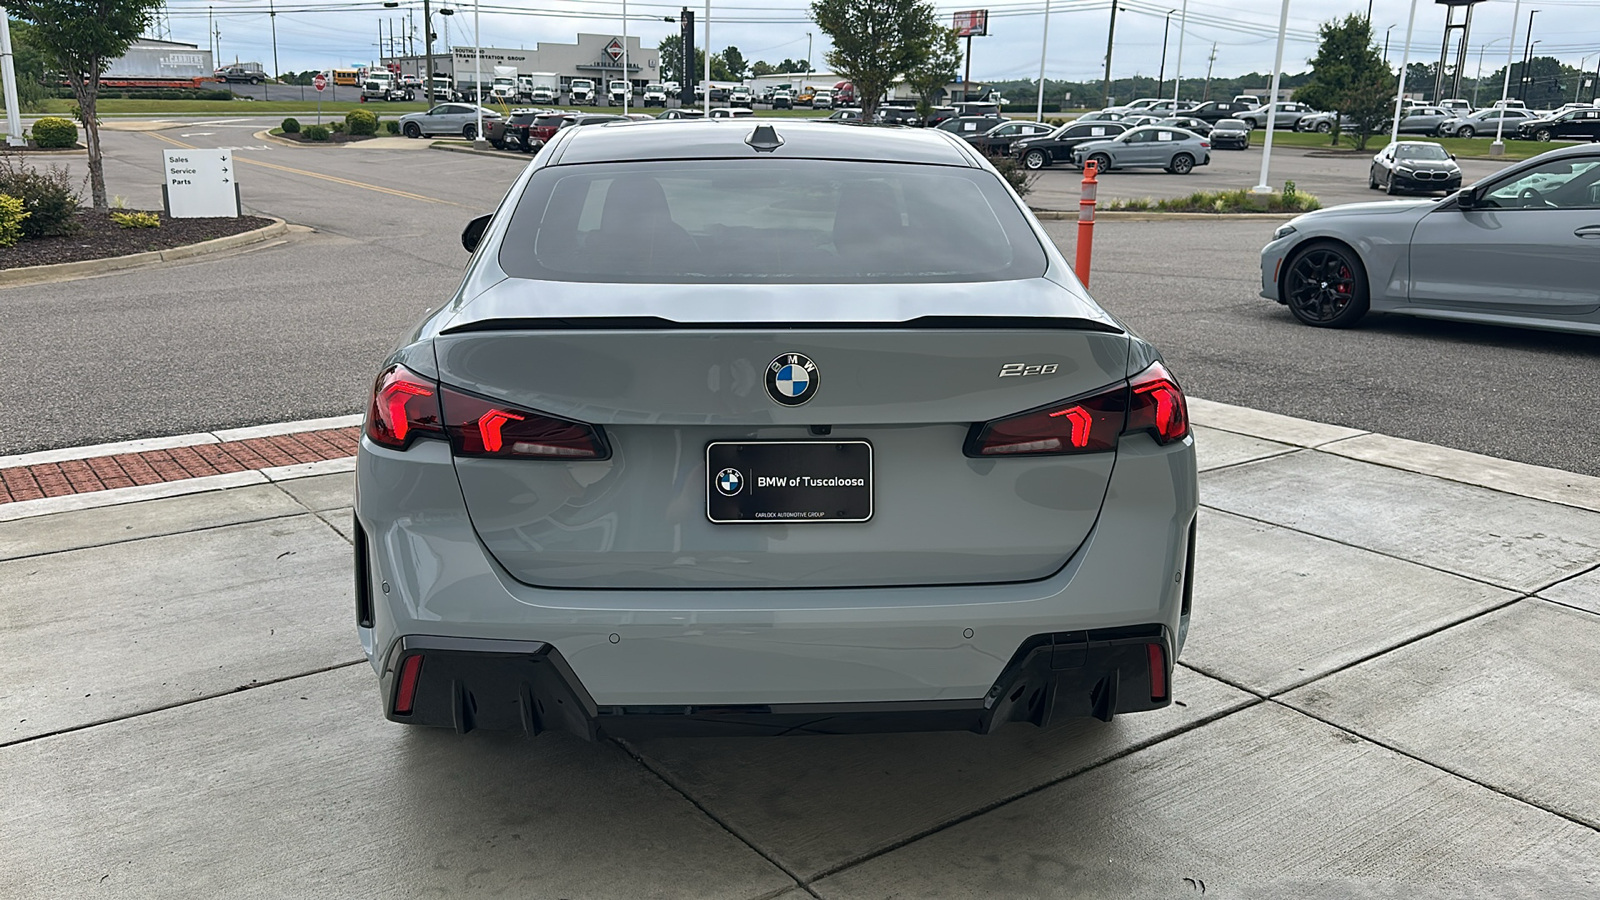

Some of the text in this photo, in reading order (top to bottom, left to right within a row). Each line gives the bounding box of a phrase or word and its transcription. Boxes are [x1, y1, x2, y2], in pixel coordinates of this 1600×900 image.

[594, 61, 639, 69] INTERNATINAL
[170, 167, 197, 175] Service
[770, 355, 815, 373] BMW
[998, 363, 1060, 378] 228
[757, 476, 865, 487] BMW of Tuscaloosa
